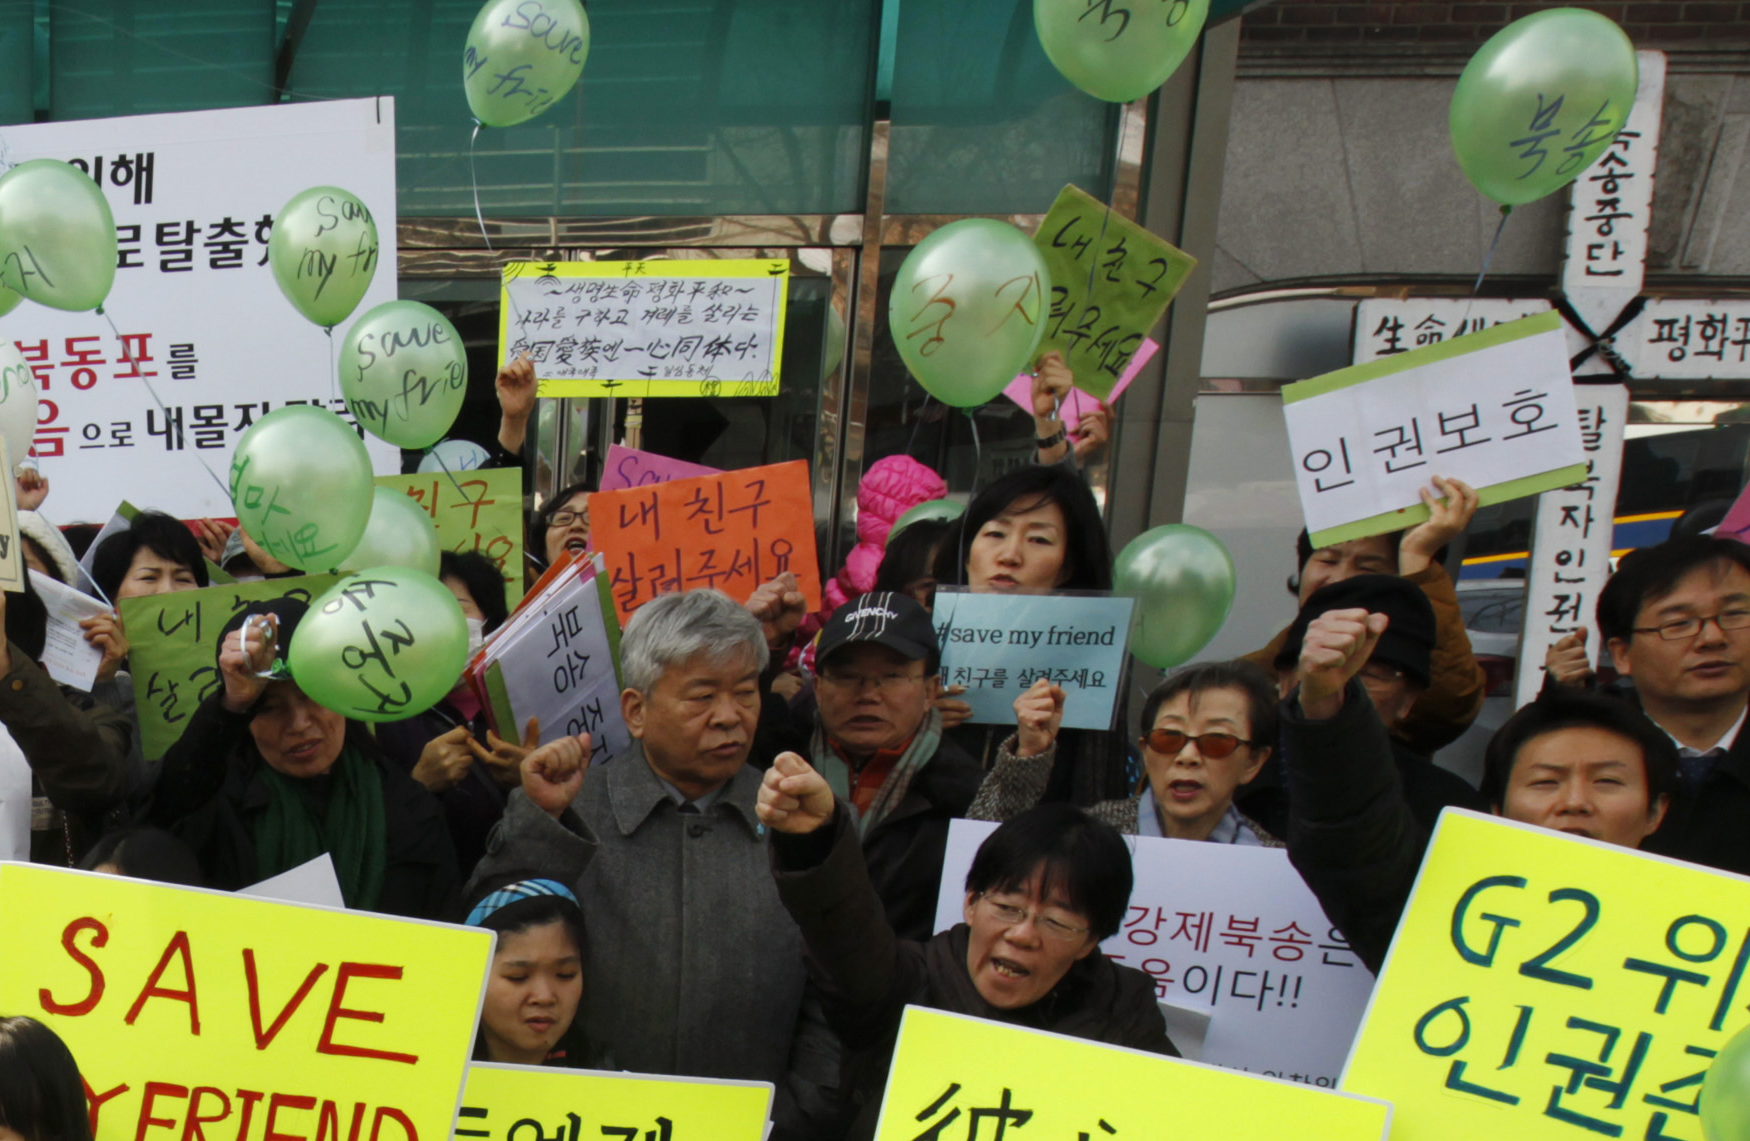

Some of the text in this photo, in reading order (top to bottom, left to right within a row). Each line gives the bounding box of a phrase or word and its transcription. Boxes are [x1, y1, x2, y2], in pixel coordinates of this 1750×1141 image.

[1302, 388, 1559, 494] 인권보호
[619, 479, 772, 541] 내 친구
[1007, 626, 1042, 650] my
[1046, 623, 1117, 647] friend
[953, 666, 1009, 690] 친구를
[1016, 666, 1108, 690] 살려주세요
[1123, 905, 1356, 969] 강제북송은
[1450, 873, 1750, 1032] G2 위
[38, 914, 420, 1067] SAVE
[1118, 955, 1304, 1012] 음이다!!
